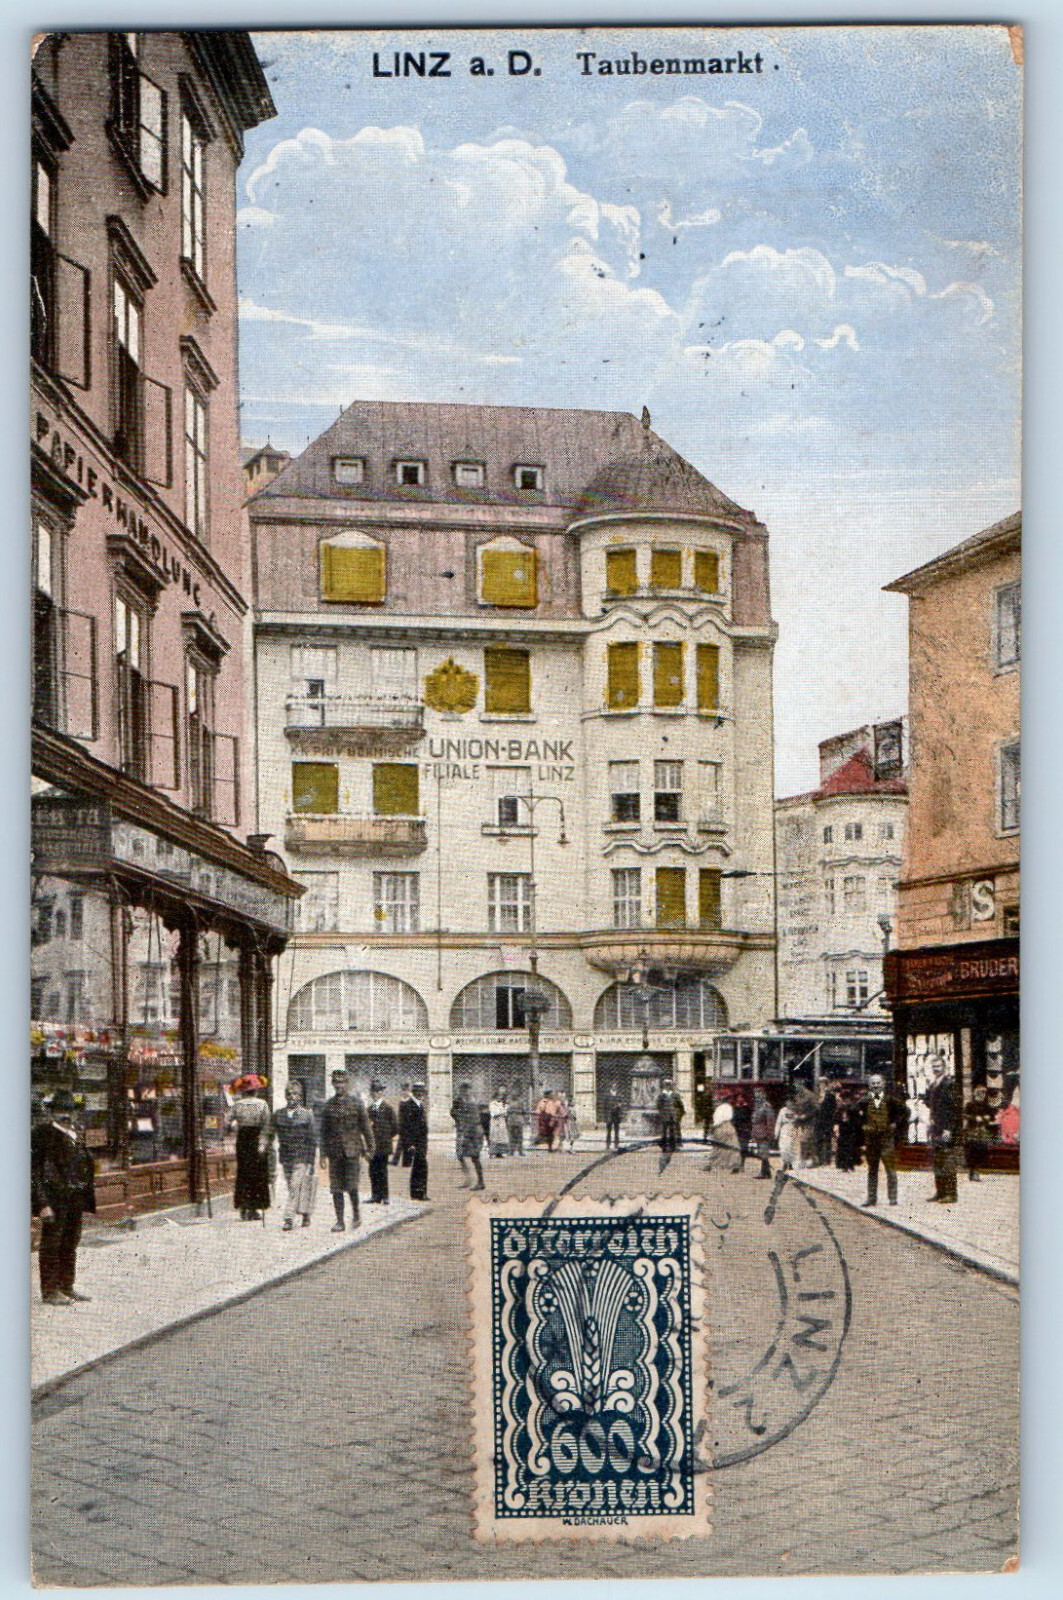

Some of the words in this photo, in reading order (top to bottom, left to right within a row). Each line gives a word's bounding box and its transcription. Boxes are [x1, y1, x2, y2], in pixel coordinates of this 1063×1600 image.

[422, 764, 480, 780] FILIALE
[538, 765, 575, 781] LINZ
[773, 1244, 836, 1393] LINZ
[551, 1419, 635, 1474] 600
